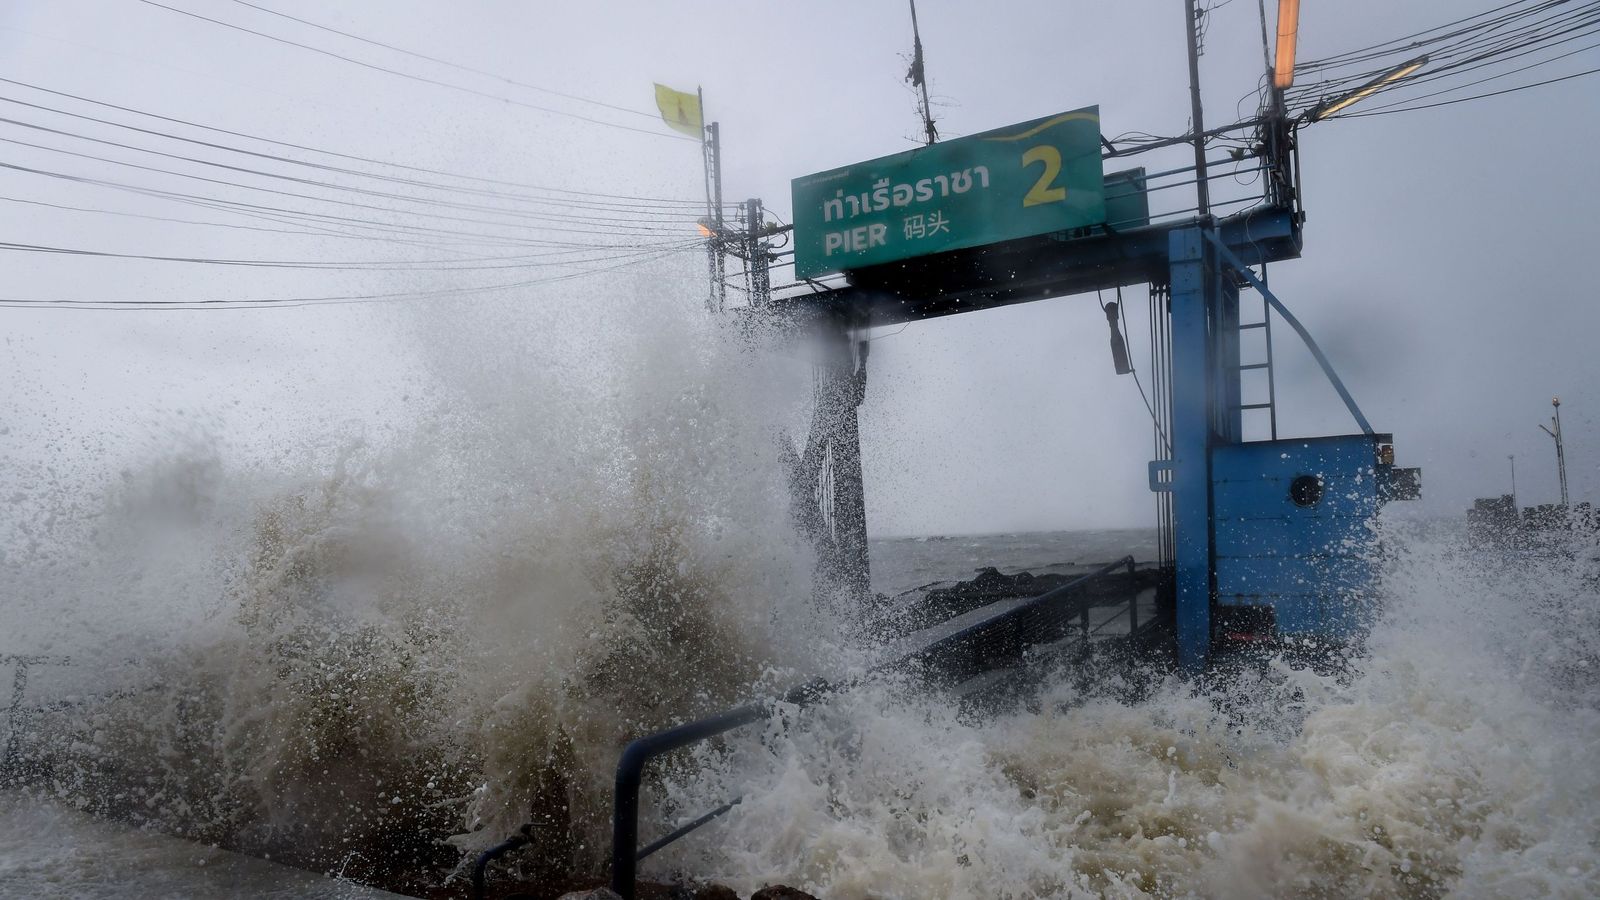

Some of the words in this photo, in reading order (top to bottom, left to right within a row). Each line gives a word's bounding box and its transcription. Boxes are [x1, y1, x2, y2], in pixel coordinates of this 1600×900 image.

[823, 165, 990, 222] ท่าเรือราชา
[1022, 145, 1066, 208] 2
[825, 223, 887, 257] PIER
[903, 209, 950, 241] 码头
